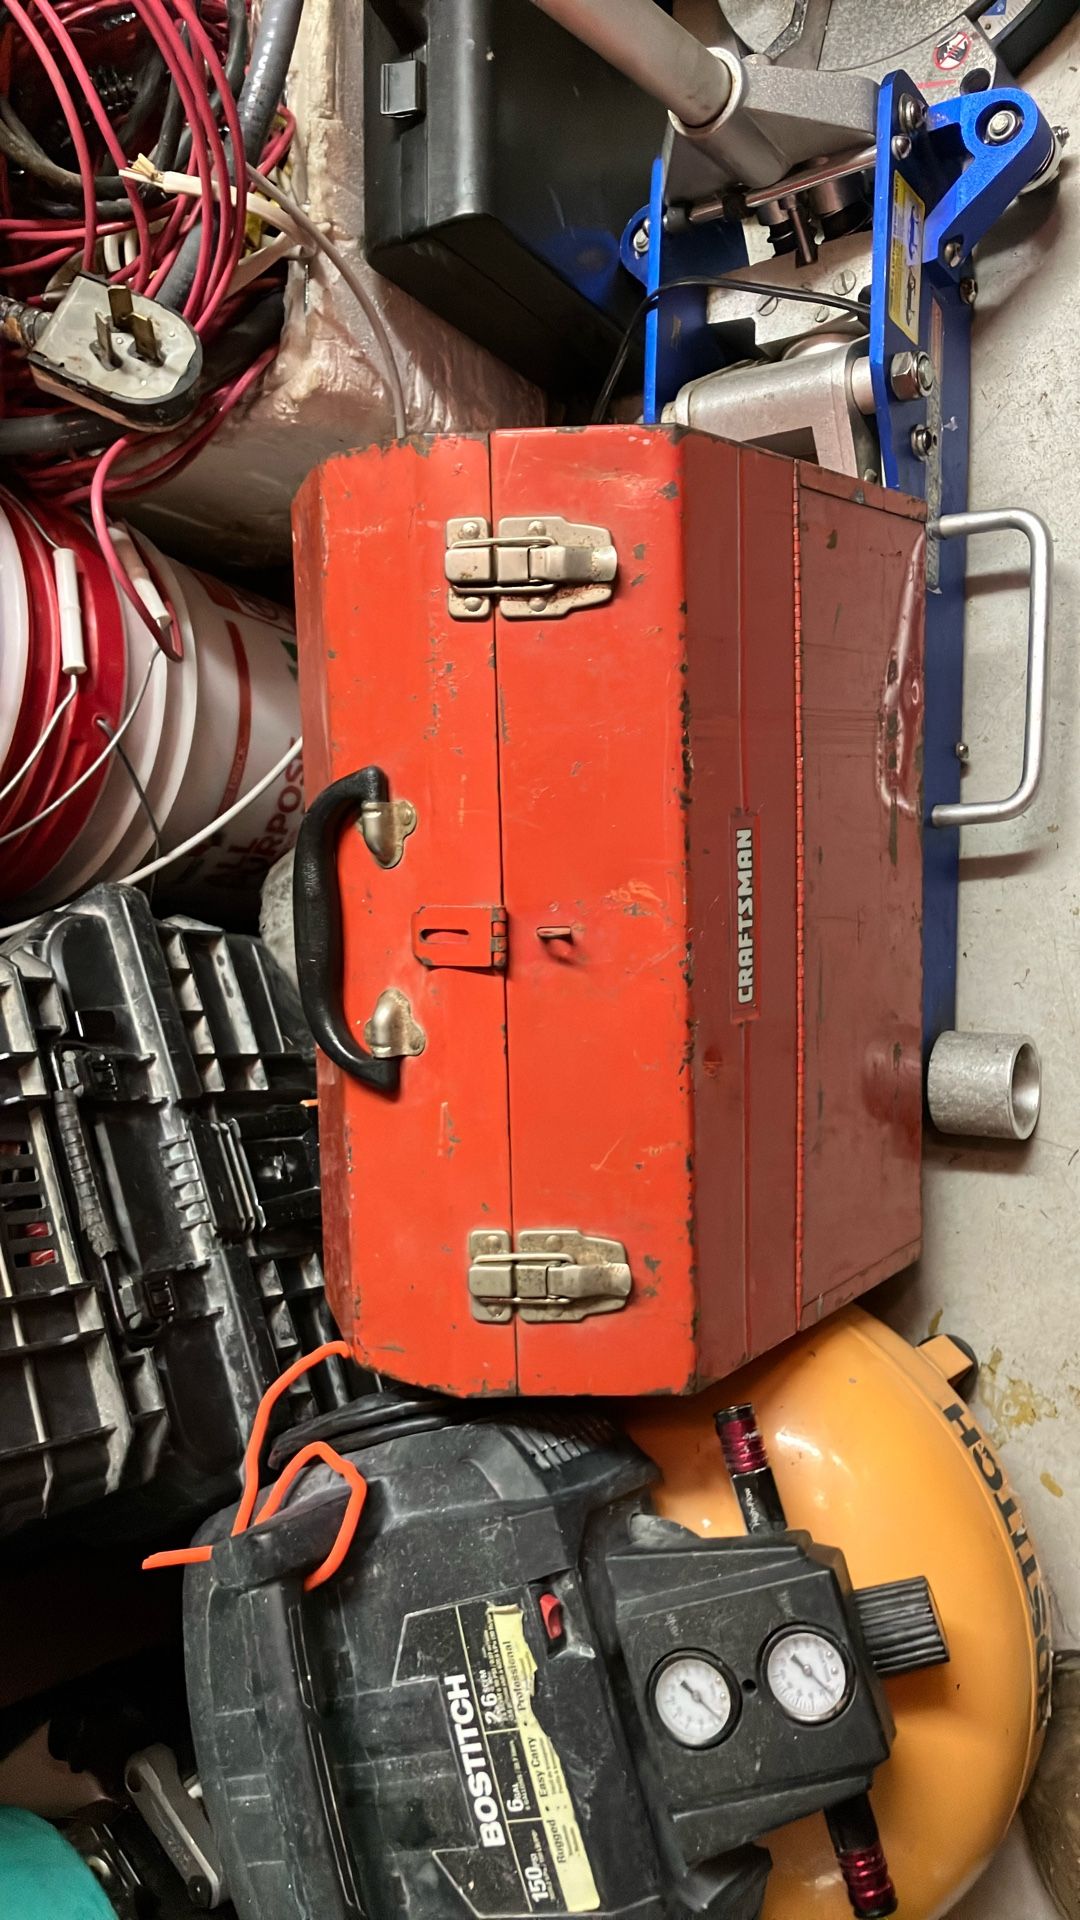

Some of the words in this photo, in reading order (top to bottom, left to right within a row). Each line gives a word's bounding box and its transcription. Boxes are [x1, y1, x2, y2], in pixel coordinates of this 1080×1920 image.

[243, 737, 304, 877] URPOS
[736, 829, 753, 1003] CRAFTSMAN
[502, 1640, 527, 1711] Professional
[443, 1673, 506, 1848] BOSTITCH
[525, 1735, 543, 1768] Carry
[533, 1769, 550, 1798] Easy
[546, 1818, 567, 1864] Rugged
[524, 1866, 549, 1903] 150
